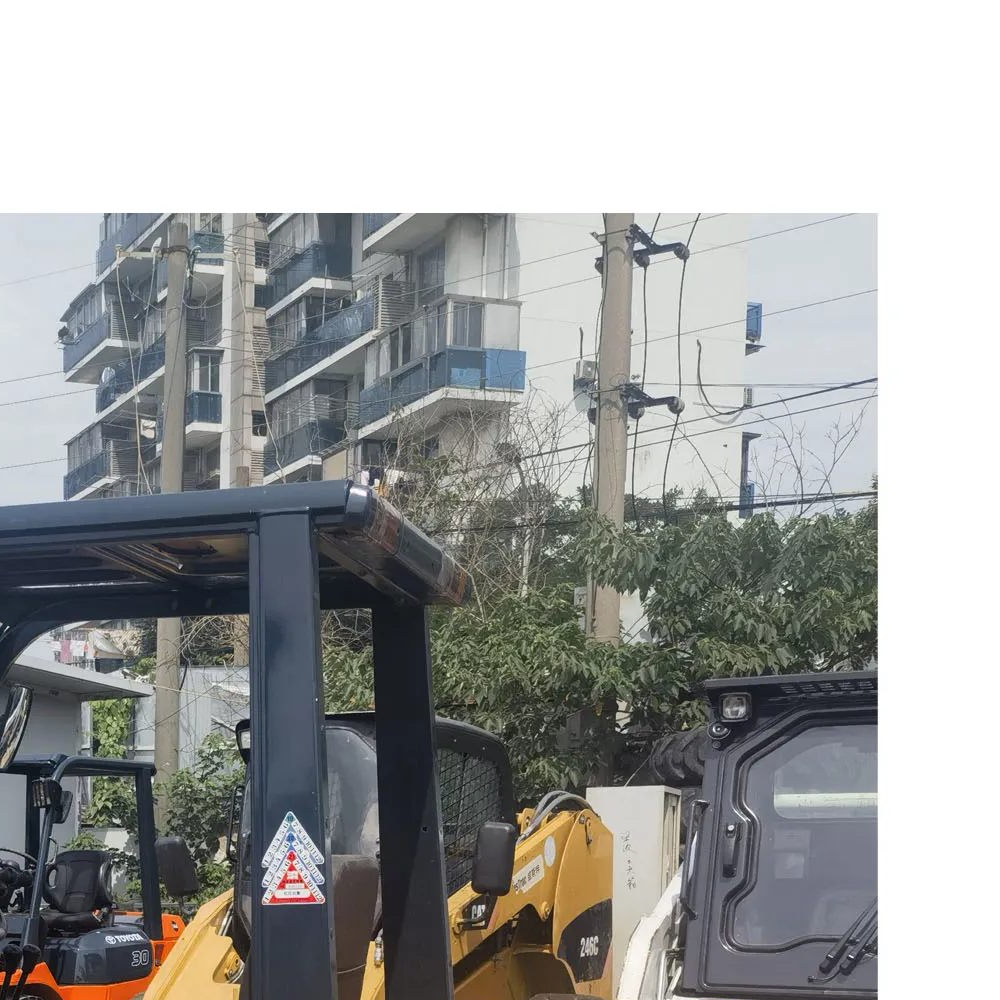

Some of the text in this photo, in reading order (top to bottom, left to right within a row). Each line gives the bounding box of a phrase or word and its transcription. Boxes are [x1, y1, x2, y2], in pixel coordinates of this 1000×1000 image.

[114, 933, 144, 942] TOYOTA
[580, 936, 599, 957] 246C
[131, 950, 149, 967] 30
